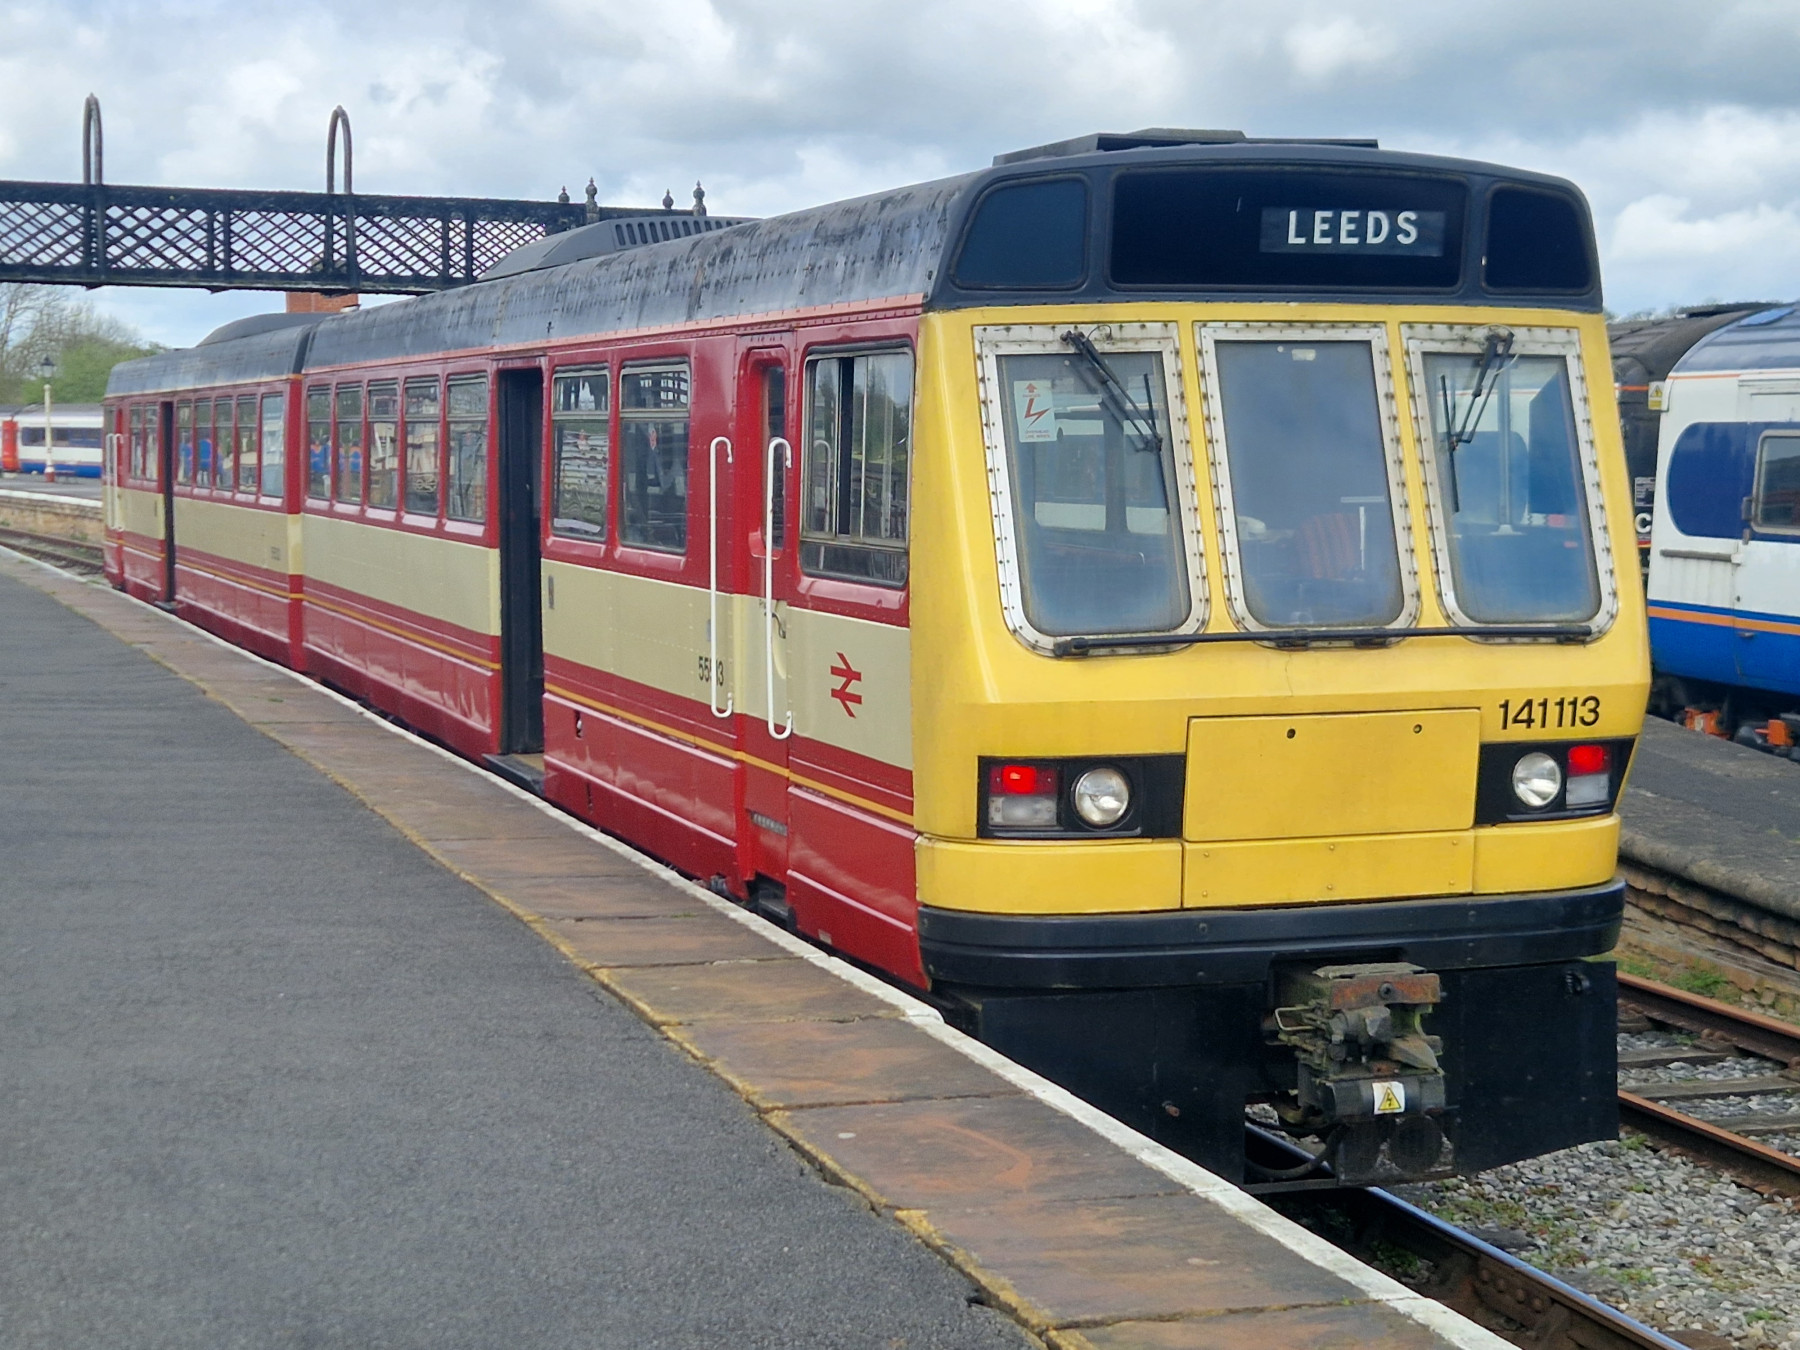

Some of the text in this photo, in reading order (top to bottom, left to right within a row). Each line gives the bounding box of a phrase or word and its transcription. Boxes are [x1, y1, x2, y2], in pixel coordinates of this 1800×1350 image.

[1287, 210, 1418, 245] LEEDS
[698, 655, 724, 687] 5513
[1498, 695, 1600, 730] 141113
